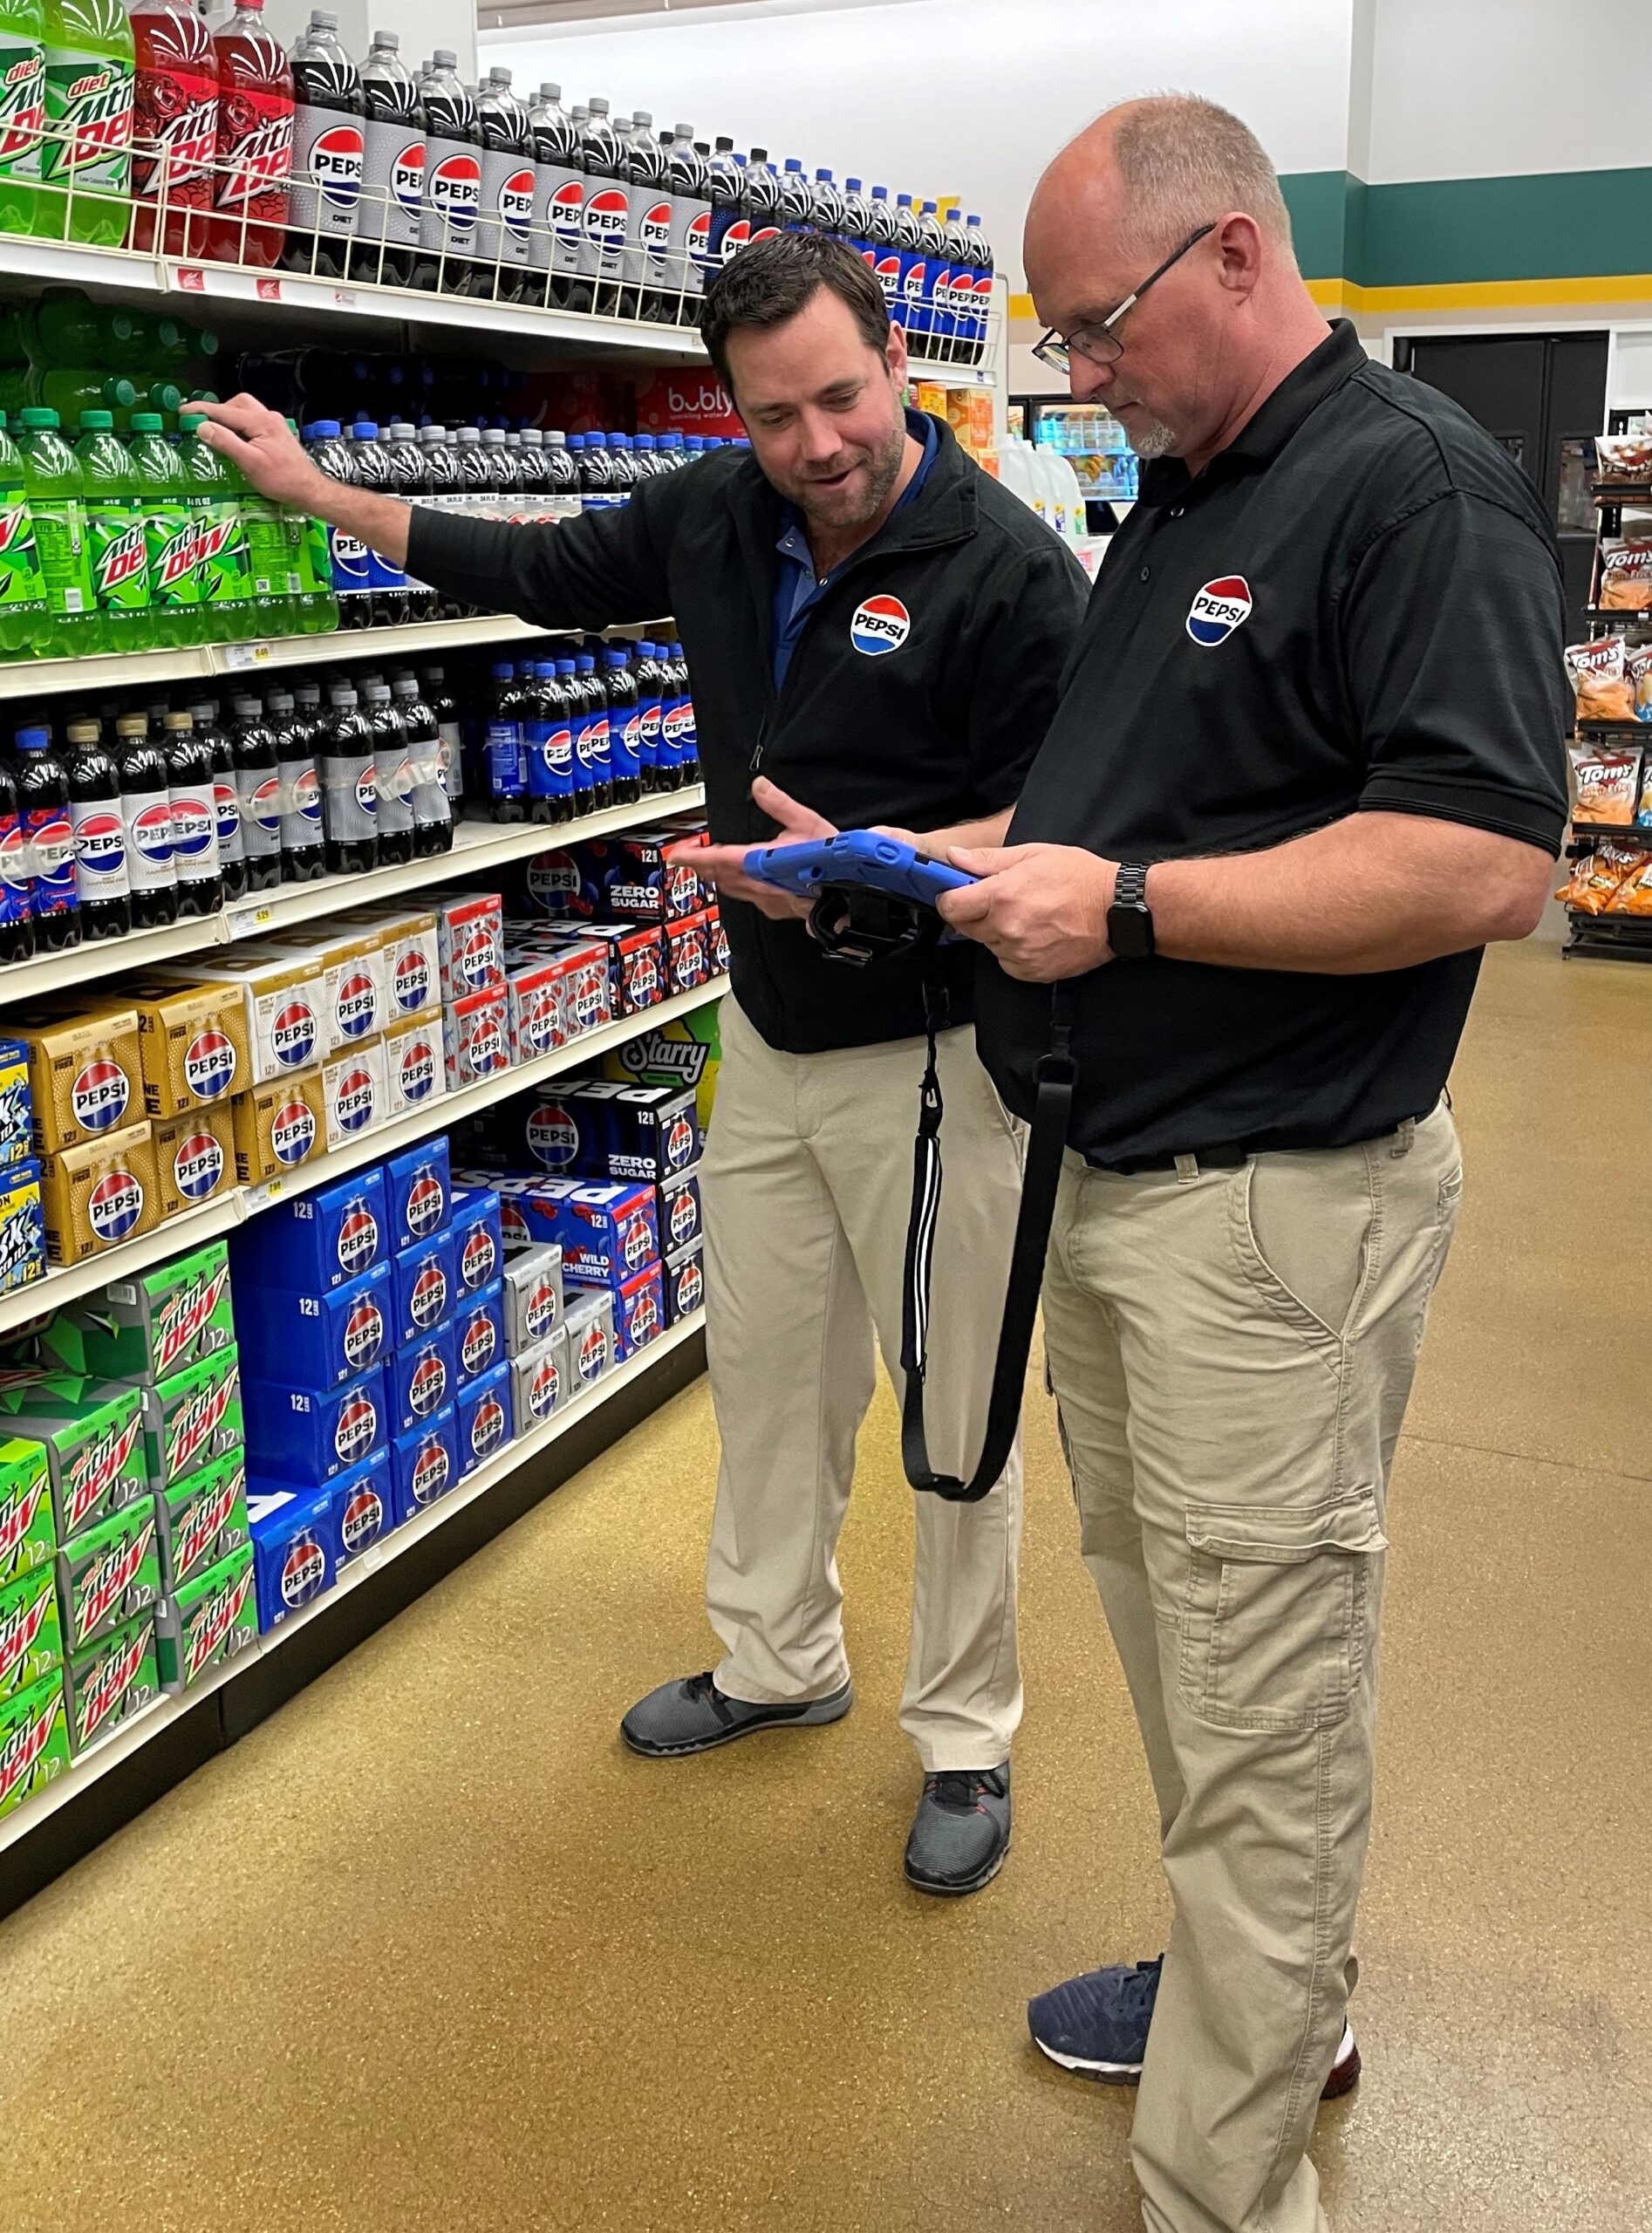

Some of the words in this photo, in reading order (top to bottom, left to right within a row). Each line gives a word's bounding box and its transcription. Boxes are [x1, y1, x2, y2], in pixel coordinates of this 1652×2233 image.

[7, 58, 39, 82] diet
[1, 73, 44, 118] Mt
[70, 72, 109, 98] diet
[315, 154, 361, 178] PEPS
[435, 181, 479, 202] PEPS
[332, 215, 352, 223] DIET
[587, 213, 626, 231] PEPS
[451, 236, 470, 244] DIET
[668, 385, 733, 418] bubly
[1194, 597, 1246, 625] PEPSI
[856, 612, 905, 641] PEPSI
[1571, 646, 1619, 669] Tom's
[1580, 764, 1633, 784] Tom's
[641, 850, 652, 863] 12
[530, 871, 577, 888] PEPSI
[674, 879, 695, 896] PEPSI
[611, 885, 659, 899] ZERO
[611, 898, 659, 909] SUGAR
[464, 951, 494, 970] PEPSI
[679, 956, 700, 973] PEPSI
[396, 971, 427, 992] PEPSI
[632, 973, 656, 991] PEPSI
[338, 995, 373, 1018] PEPSI
[577, 994, 602, 1012] PEPSI
[275, 1022, 314, 1046] PEPSI
[532, 1015, 557, 1035] PEPSI
[471, 1037, 500, 1057] PEPSI
[623, 1032, 707, 1083] Starry
[189, 1051, 232, 1078] PEPSI
[402, 1062, 433, 1083] PEPSI
[77, 1082, 126, 1110] PEPSI
[338, 1090, 372, 1114] PEPSI
[638, 1110, 648, 1124] 12
[275, 1119, 312, 1145] PEPSI
[529, 1127, 576, 1145] PEPSI
[10, 1144, 24, 1161] 12
[670, 1134, 691, 1153] PEPSI
[178, 1151, 220, 1180] PEPSI
[609, 1154, 657, 1170] ZERO
[609, 1166, 657, 1179] SUGAR
[93, 1190, 140, 1221] PEPSI
[293, 1201, 306, 1218] 12
[409, 1196, 440, 1219] PEPSI
[591, 1214, 601, 1228] 12
[673, 1208, 694, 1229] PEPSI
[340, 1227, 375, 1256] PEPSI
[627, 1236, 650, 1257] PEPSI
[464, 1247, 493, 1271] PEPSI
[562, 1262, 609, 1278] CHERRY
[579, 1253, 609, 1265] WILD
[23, 1264, 35, 1282] 12
[413, 1285, 445, 1311] PEPSI
[679, 1280, 700, 1301] PEPSI
[299, 1298, 313, 1315] 12
[528, 1300, 554, 1324] PEPSI
[632, 1312, 655, 1333] PEPSI
[347, 1323, 380, 1352] PEPSI
[464, 1333, 493, 1359] PEPSI
[580, 1343, 605, 1368] PEPSI
[412, 1374, 444, 1399] PEPSI
[531, 1381, 556, 1405] PEPSI
[290, 1394, 304, 1410] 12
[338, 1417, 373, 1446] PEPSI
[474, 1416, 502, 1443] PEPSI
[415, 1461, 447, 1490] PEPSI
[345, 1508, 379, 1538] PEPSI
[27, 1540, 45, 1567] 12
[283, 1560, 322, 1593] PEPSI
[33, 1651, 51, 1676] 12
[43, 1756, 60, 1782] 12
